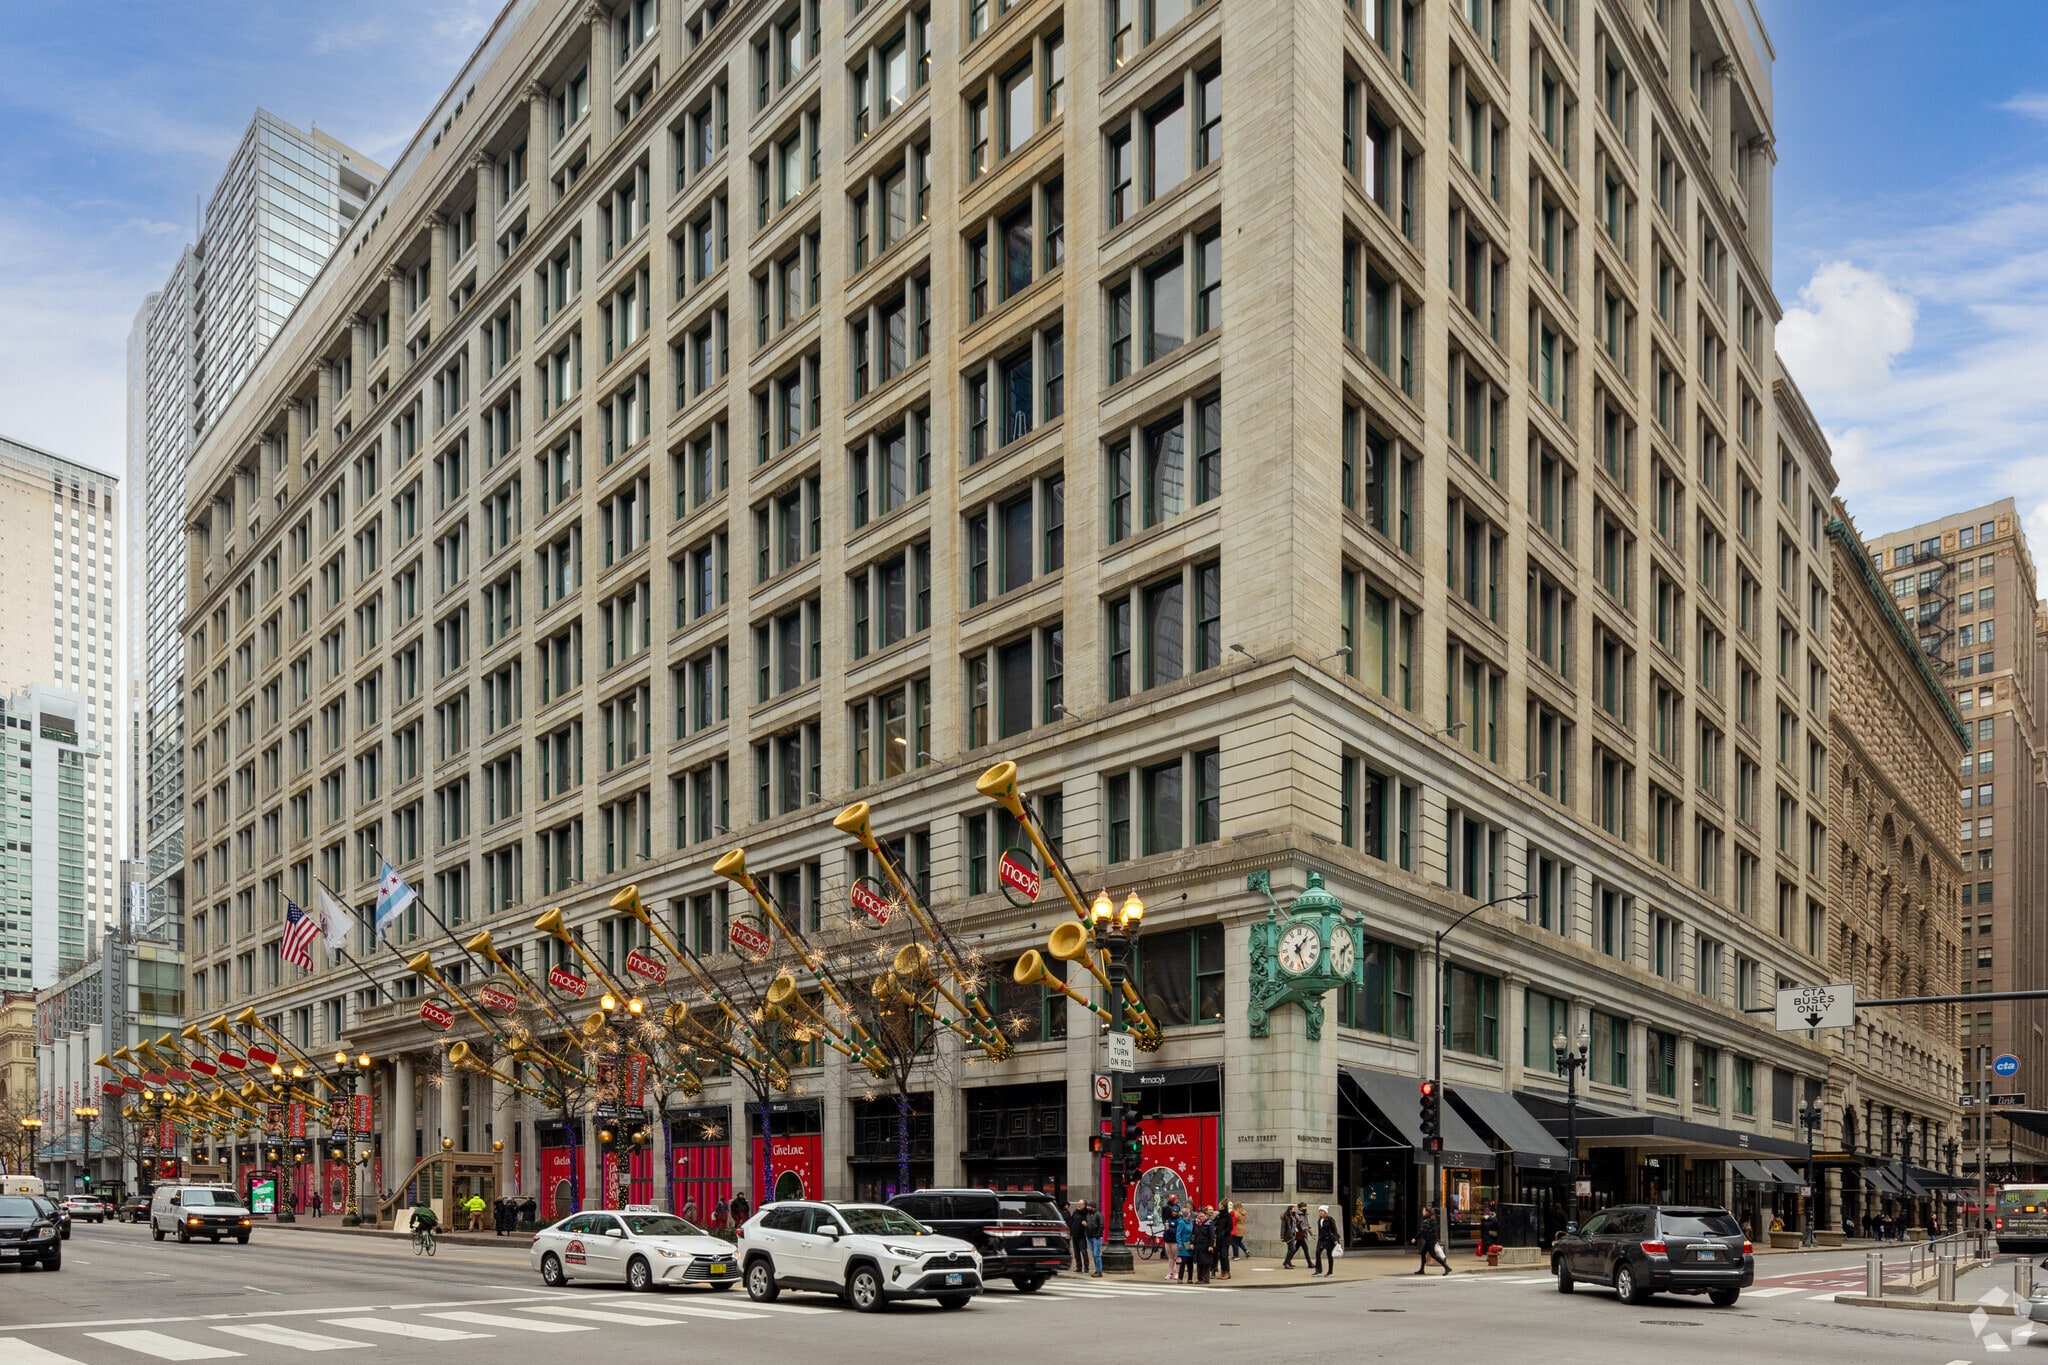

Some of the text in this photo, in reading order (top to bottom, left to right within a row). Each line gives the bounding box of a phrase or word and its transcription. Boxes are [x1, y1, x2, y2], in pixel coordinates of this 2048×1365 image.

[1002, 860, 1038, 894] macy's
[853, 886, 888, 918] macy's
[732, 926, 769, 953] macy's
[112, 943, 122, 1006] BALLET
[628, 955, 665, 980] macy's
[550, 971, 586, 994] macy's
[1794, 995, 1834, 1006] BUSES
[1802, 988, 1826, 996] CTA
[482, 990, 515, 1012] macy's
[1797, 1004, 1831, 1014] ONLY
[422, 1004, 453, 1024] macy's
[1114, 1048, 1129, 1056] TURN
[1110, 1058, 1132, 1067] ON RED
[1996, 1062, 2015, 1070] cta
[1146, 1074, 1166, 1084] macy's
[1141, 1131, 1157, 1146] ive
